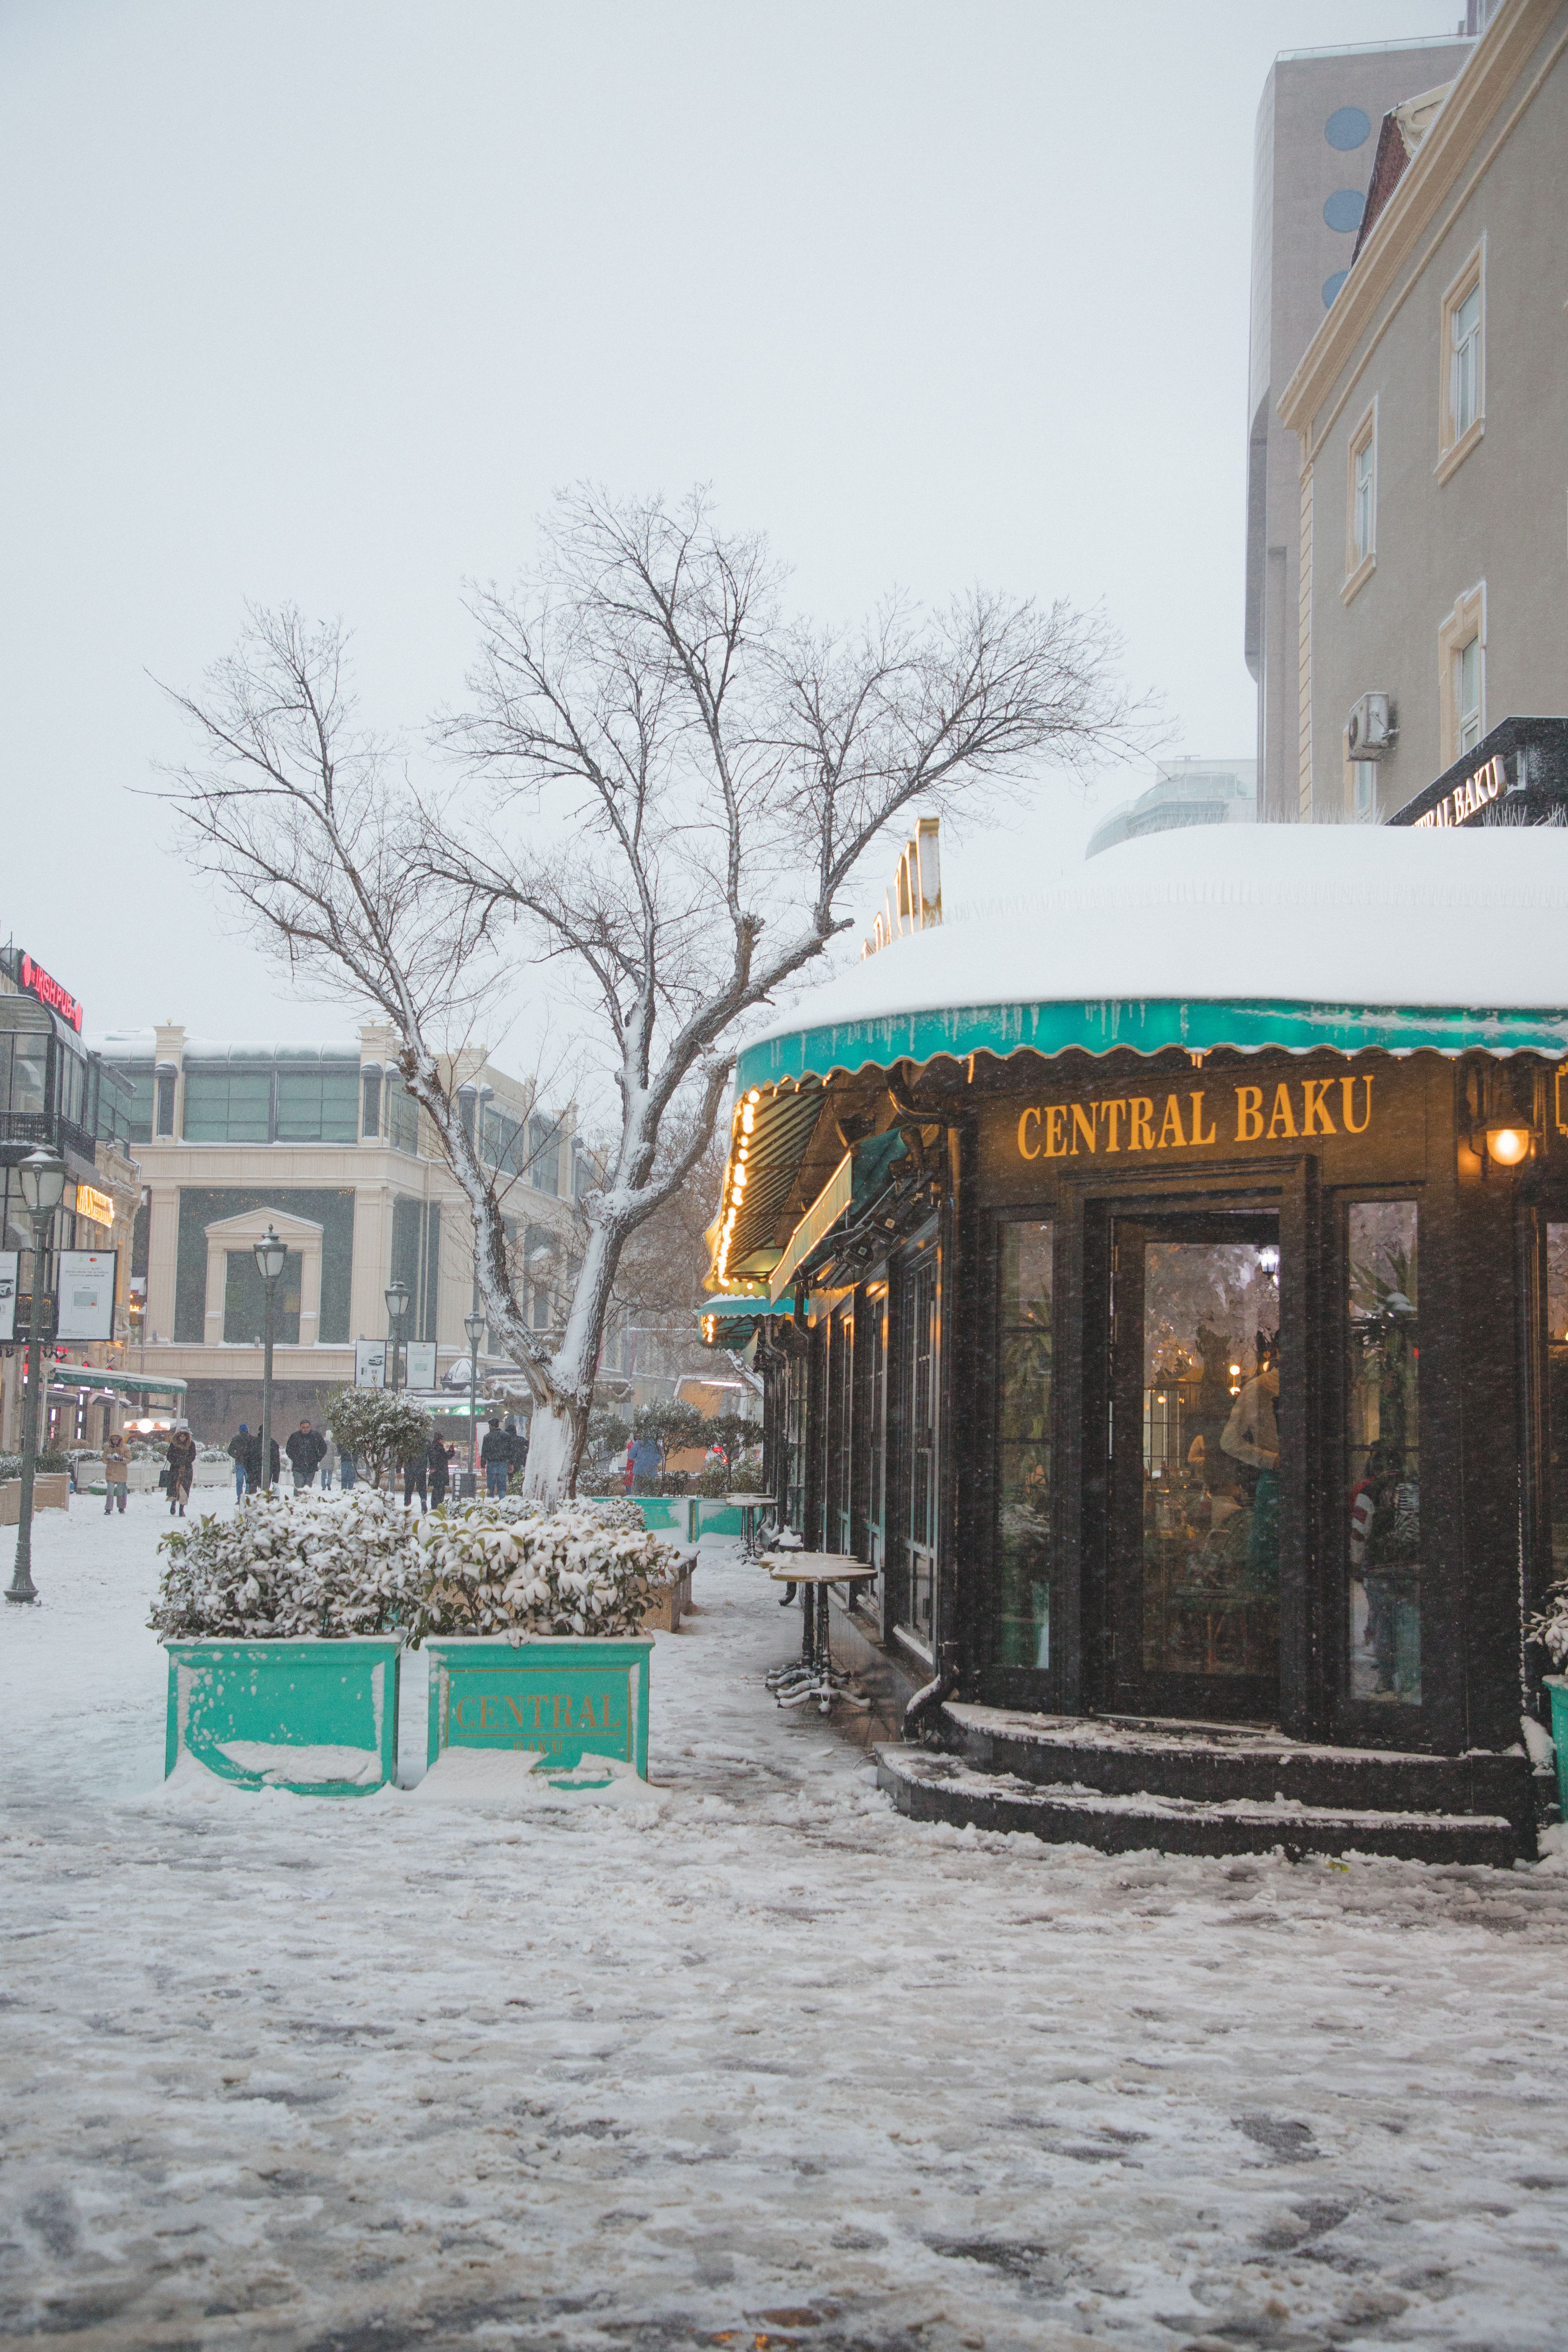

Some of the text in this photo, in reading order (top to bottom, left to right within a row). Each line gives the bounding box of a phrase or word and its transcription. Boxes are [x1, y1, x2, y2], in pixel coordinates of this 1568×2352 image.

[1453, 756, 1499, 825] BAKU
[34, 966, 56, 1005] IRISH
[55, 985, 72, 1018] PUB
[1017, 1075, 1374, 1160] CENTRAL BAKU
[456, 1694, 621, 1729] CENTRAL
[514, 1740, 562, 1755] BAKU
